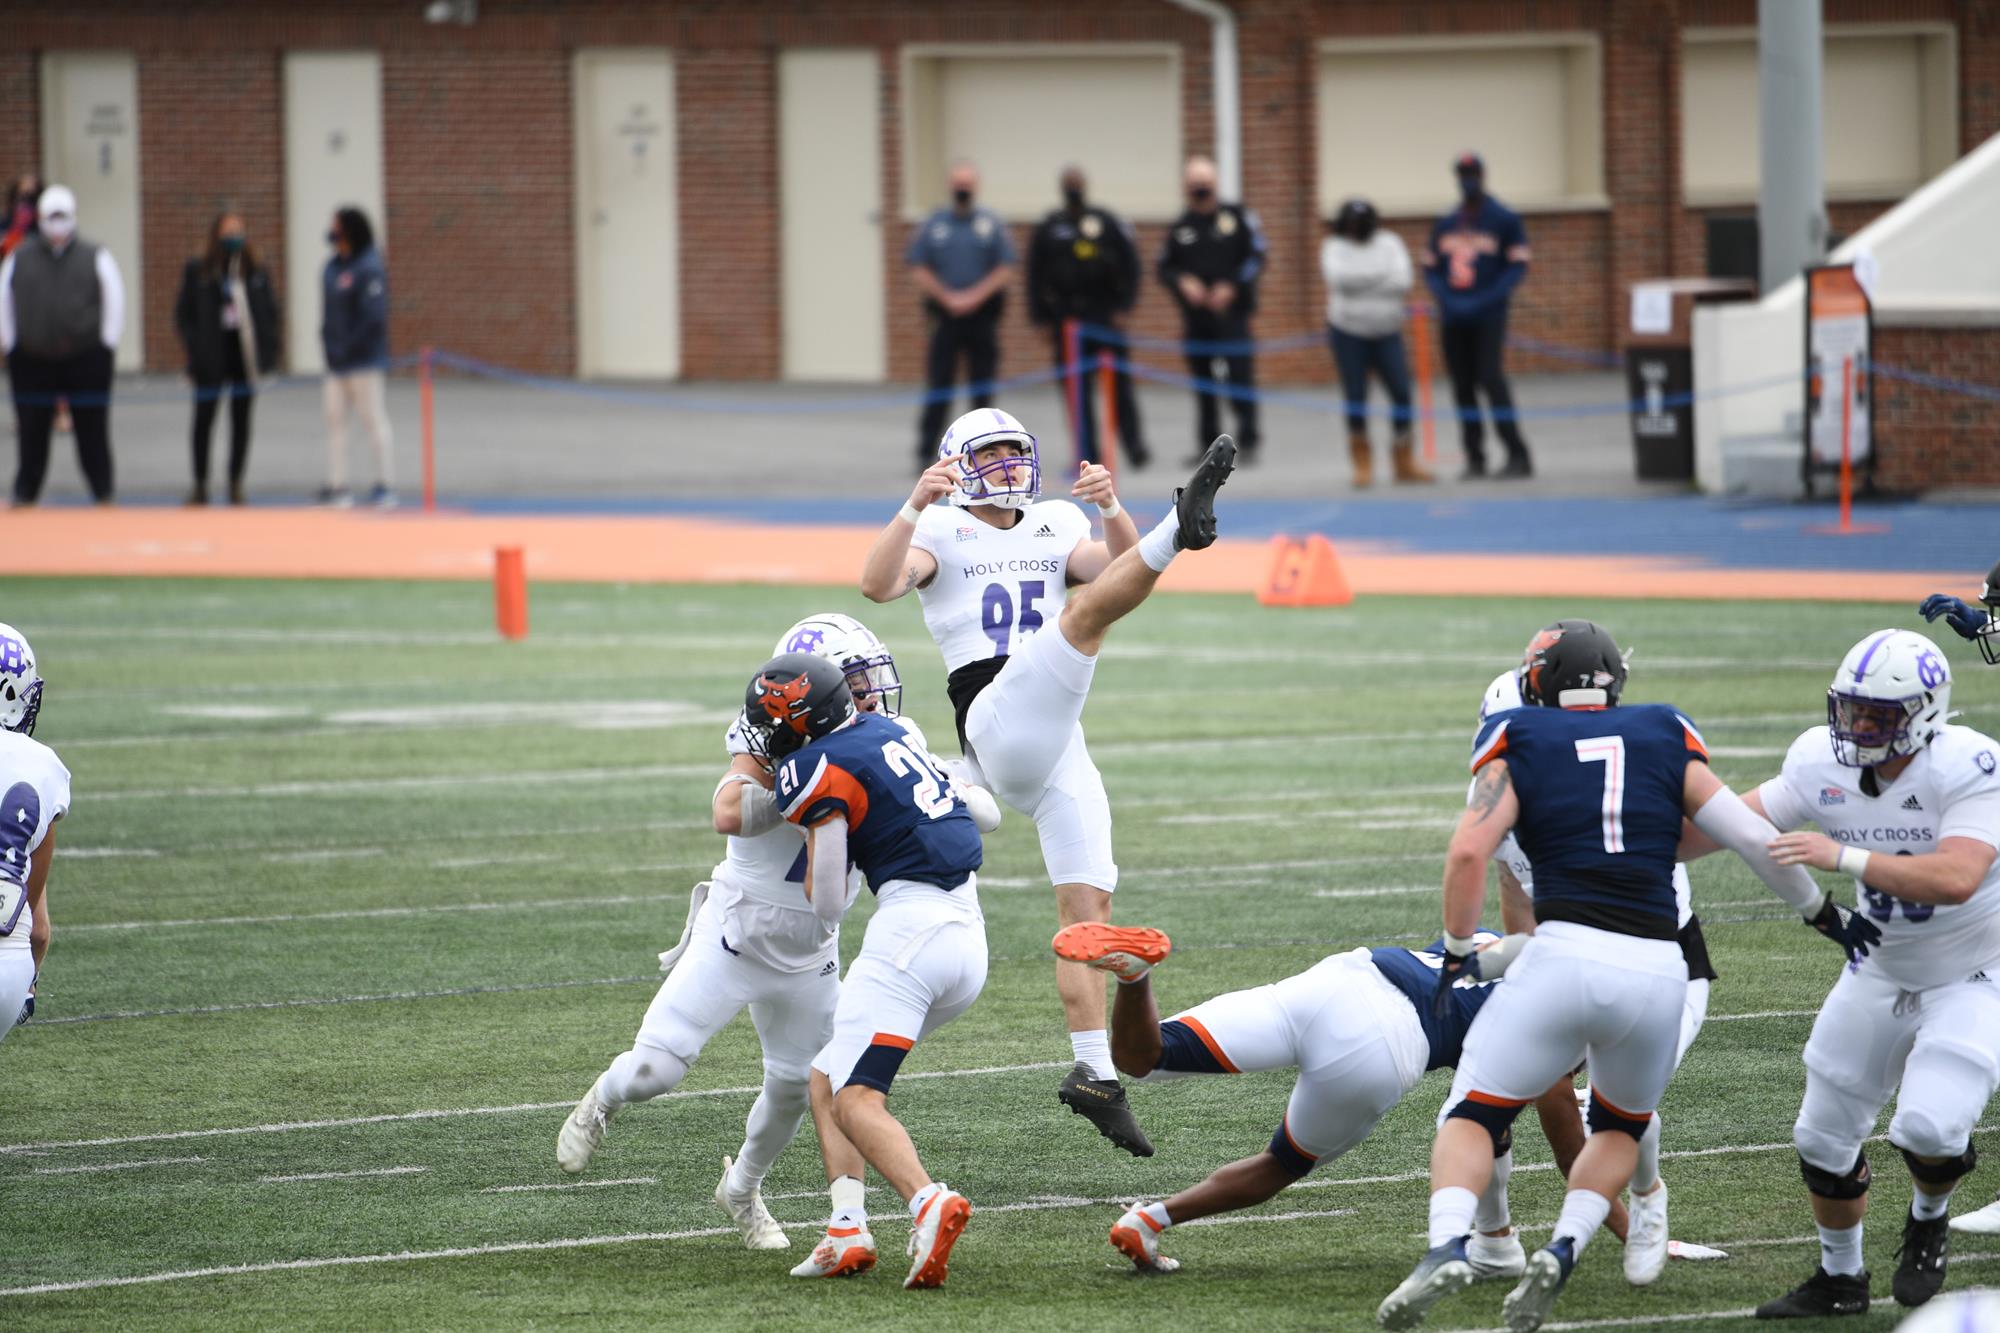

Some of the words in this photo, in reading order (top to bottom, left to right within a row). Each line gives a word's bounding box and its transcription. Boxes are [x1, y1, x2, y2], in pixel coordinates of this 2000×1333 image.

[963, 561, 1004, 579] HOLY
[1009, 559, 1059, 573] CROSS
[981, 580, 1045, 656] 95
[779, 758, 800, 797] 21
[1574, 734, 1626, 854] 7
[1828, 828, 1869, 843] HOLY
[1872, 827, 1933, 842] CROSS
[1075, 1083, 1111, 1100] NEMESIS
